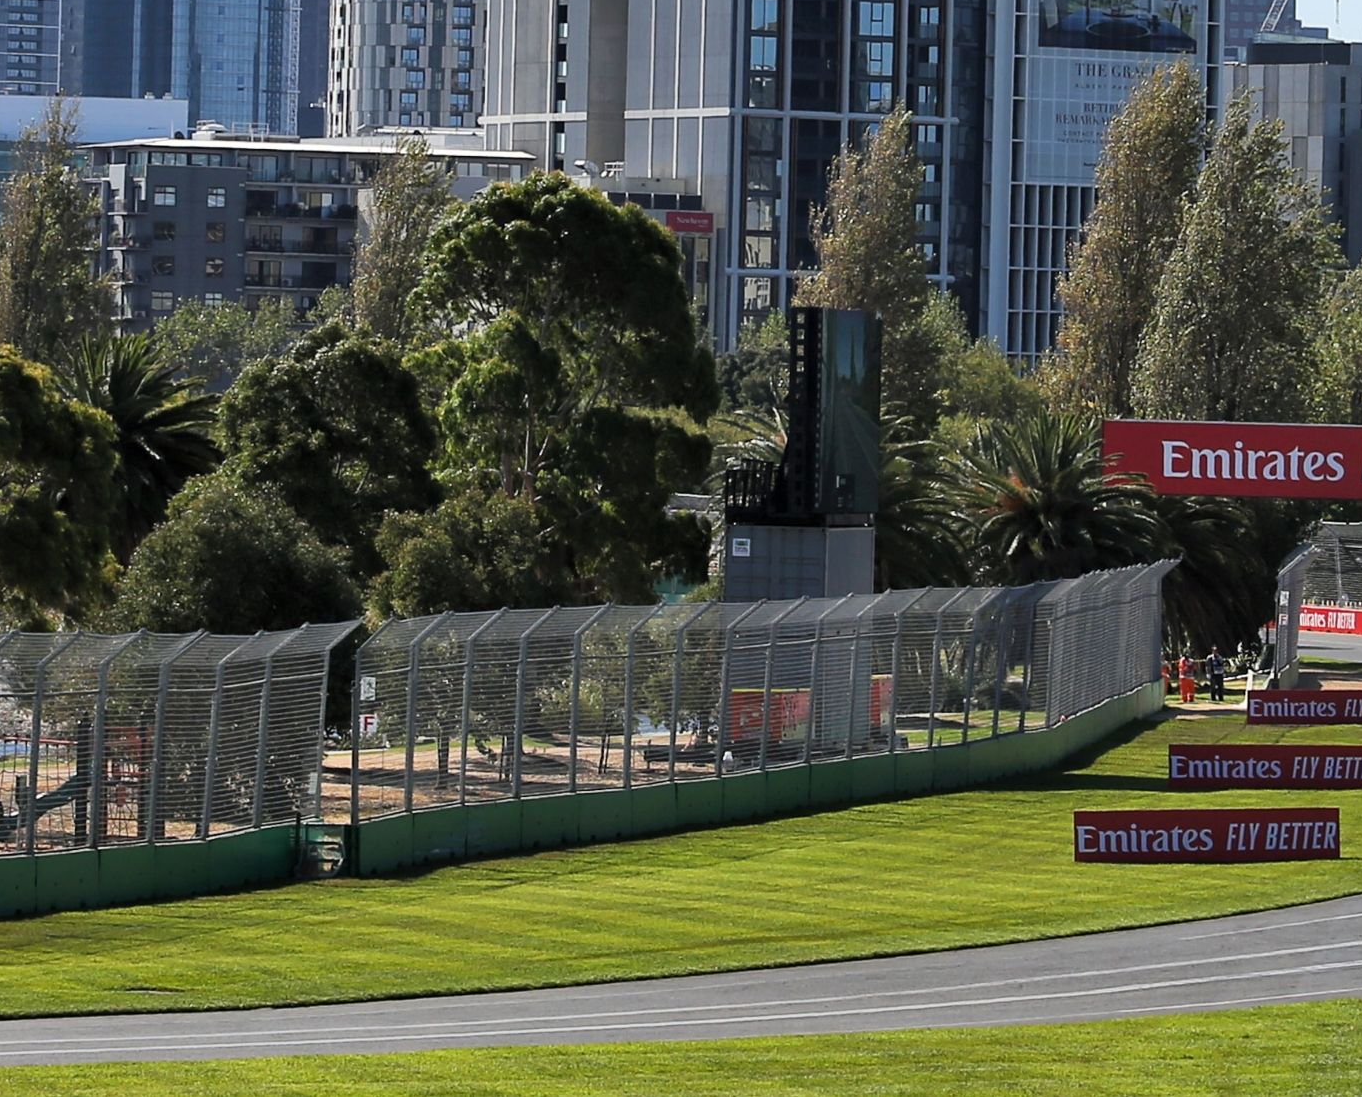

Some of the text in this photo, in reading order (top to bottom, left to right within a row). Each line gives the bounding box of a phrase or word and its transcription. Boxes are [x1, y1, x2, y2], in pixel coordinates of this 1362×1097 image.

[1075, 63, 1107, 77] THE
[1162, 441, 1344, 481] Emirates
[1299, 609, 1326, 627] mirates
[1249, 698, 1337, 718] Emirates
[364, 716, 375, 732] F
[1171, 754, 1282, 779] Emirates
[1292, 756, 1320, 780] FLY
[1076, 821, 1337, 853] Emirates FLY BETTER
